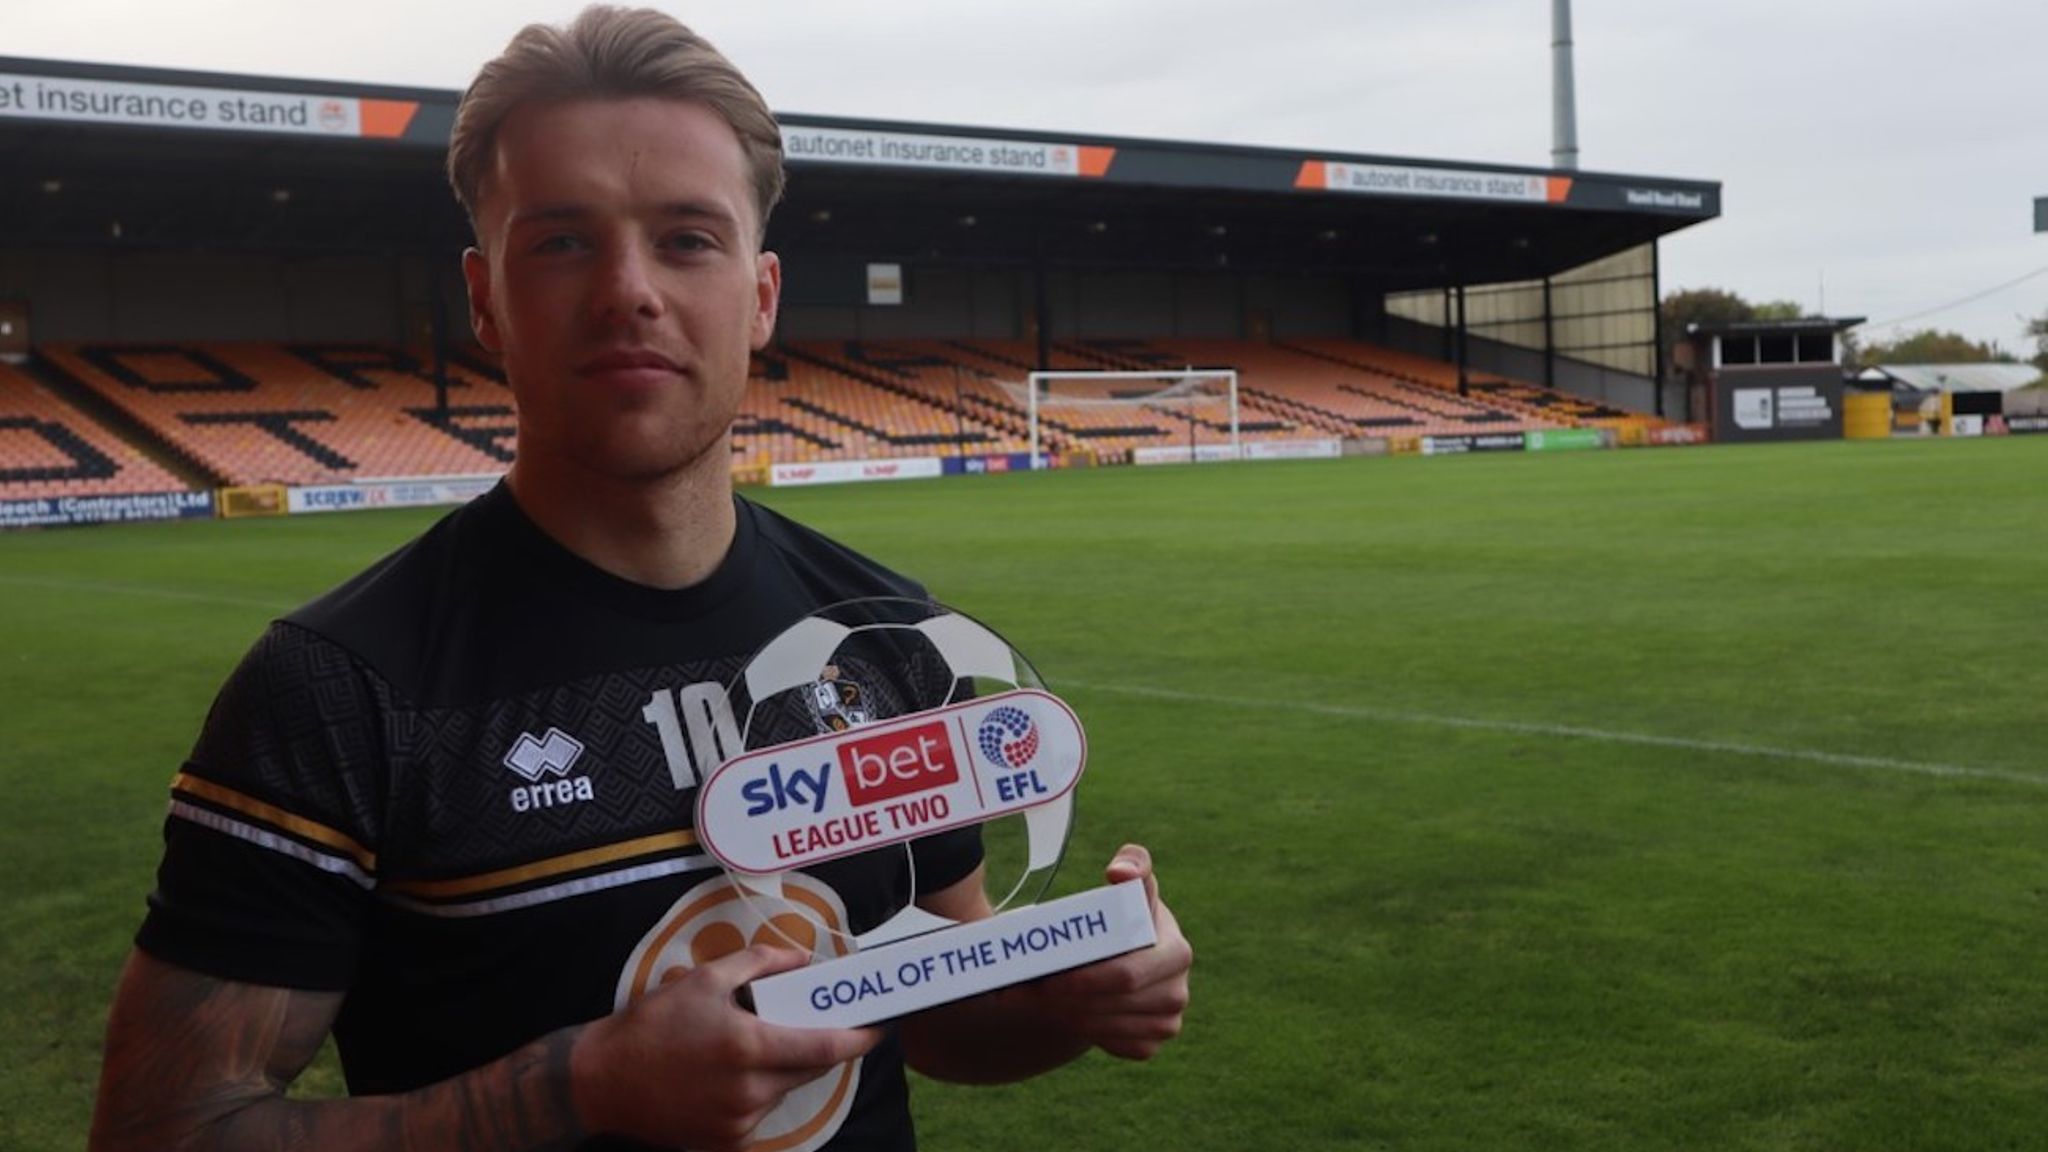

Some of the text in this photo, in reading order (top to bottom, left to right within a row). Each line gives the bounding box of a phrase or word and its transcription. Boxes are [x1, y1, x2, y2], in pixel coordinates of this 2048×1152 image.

[37, 83, 207, 121] insurance
[218, 100, 307, 126] stand
[788, 132, 1046, 168] autonet insurance stand
[1352, 166, 1526, 196] autonet insurance stand
[742, 735, 945, 817] sky bet
[996, 768, 1047, 803] EFL
[772, 793, 950, 860] LEAGUE TWO
[810, 909, 1108, 1012] GOAL OF THE MONTH
